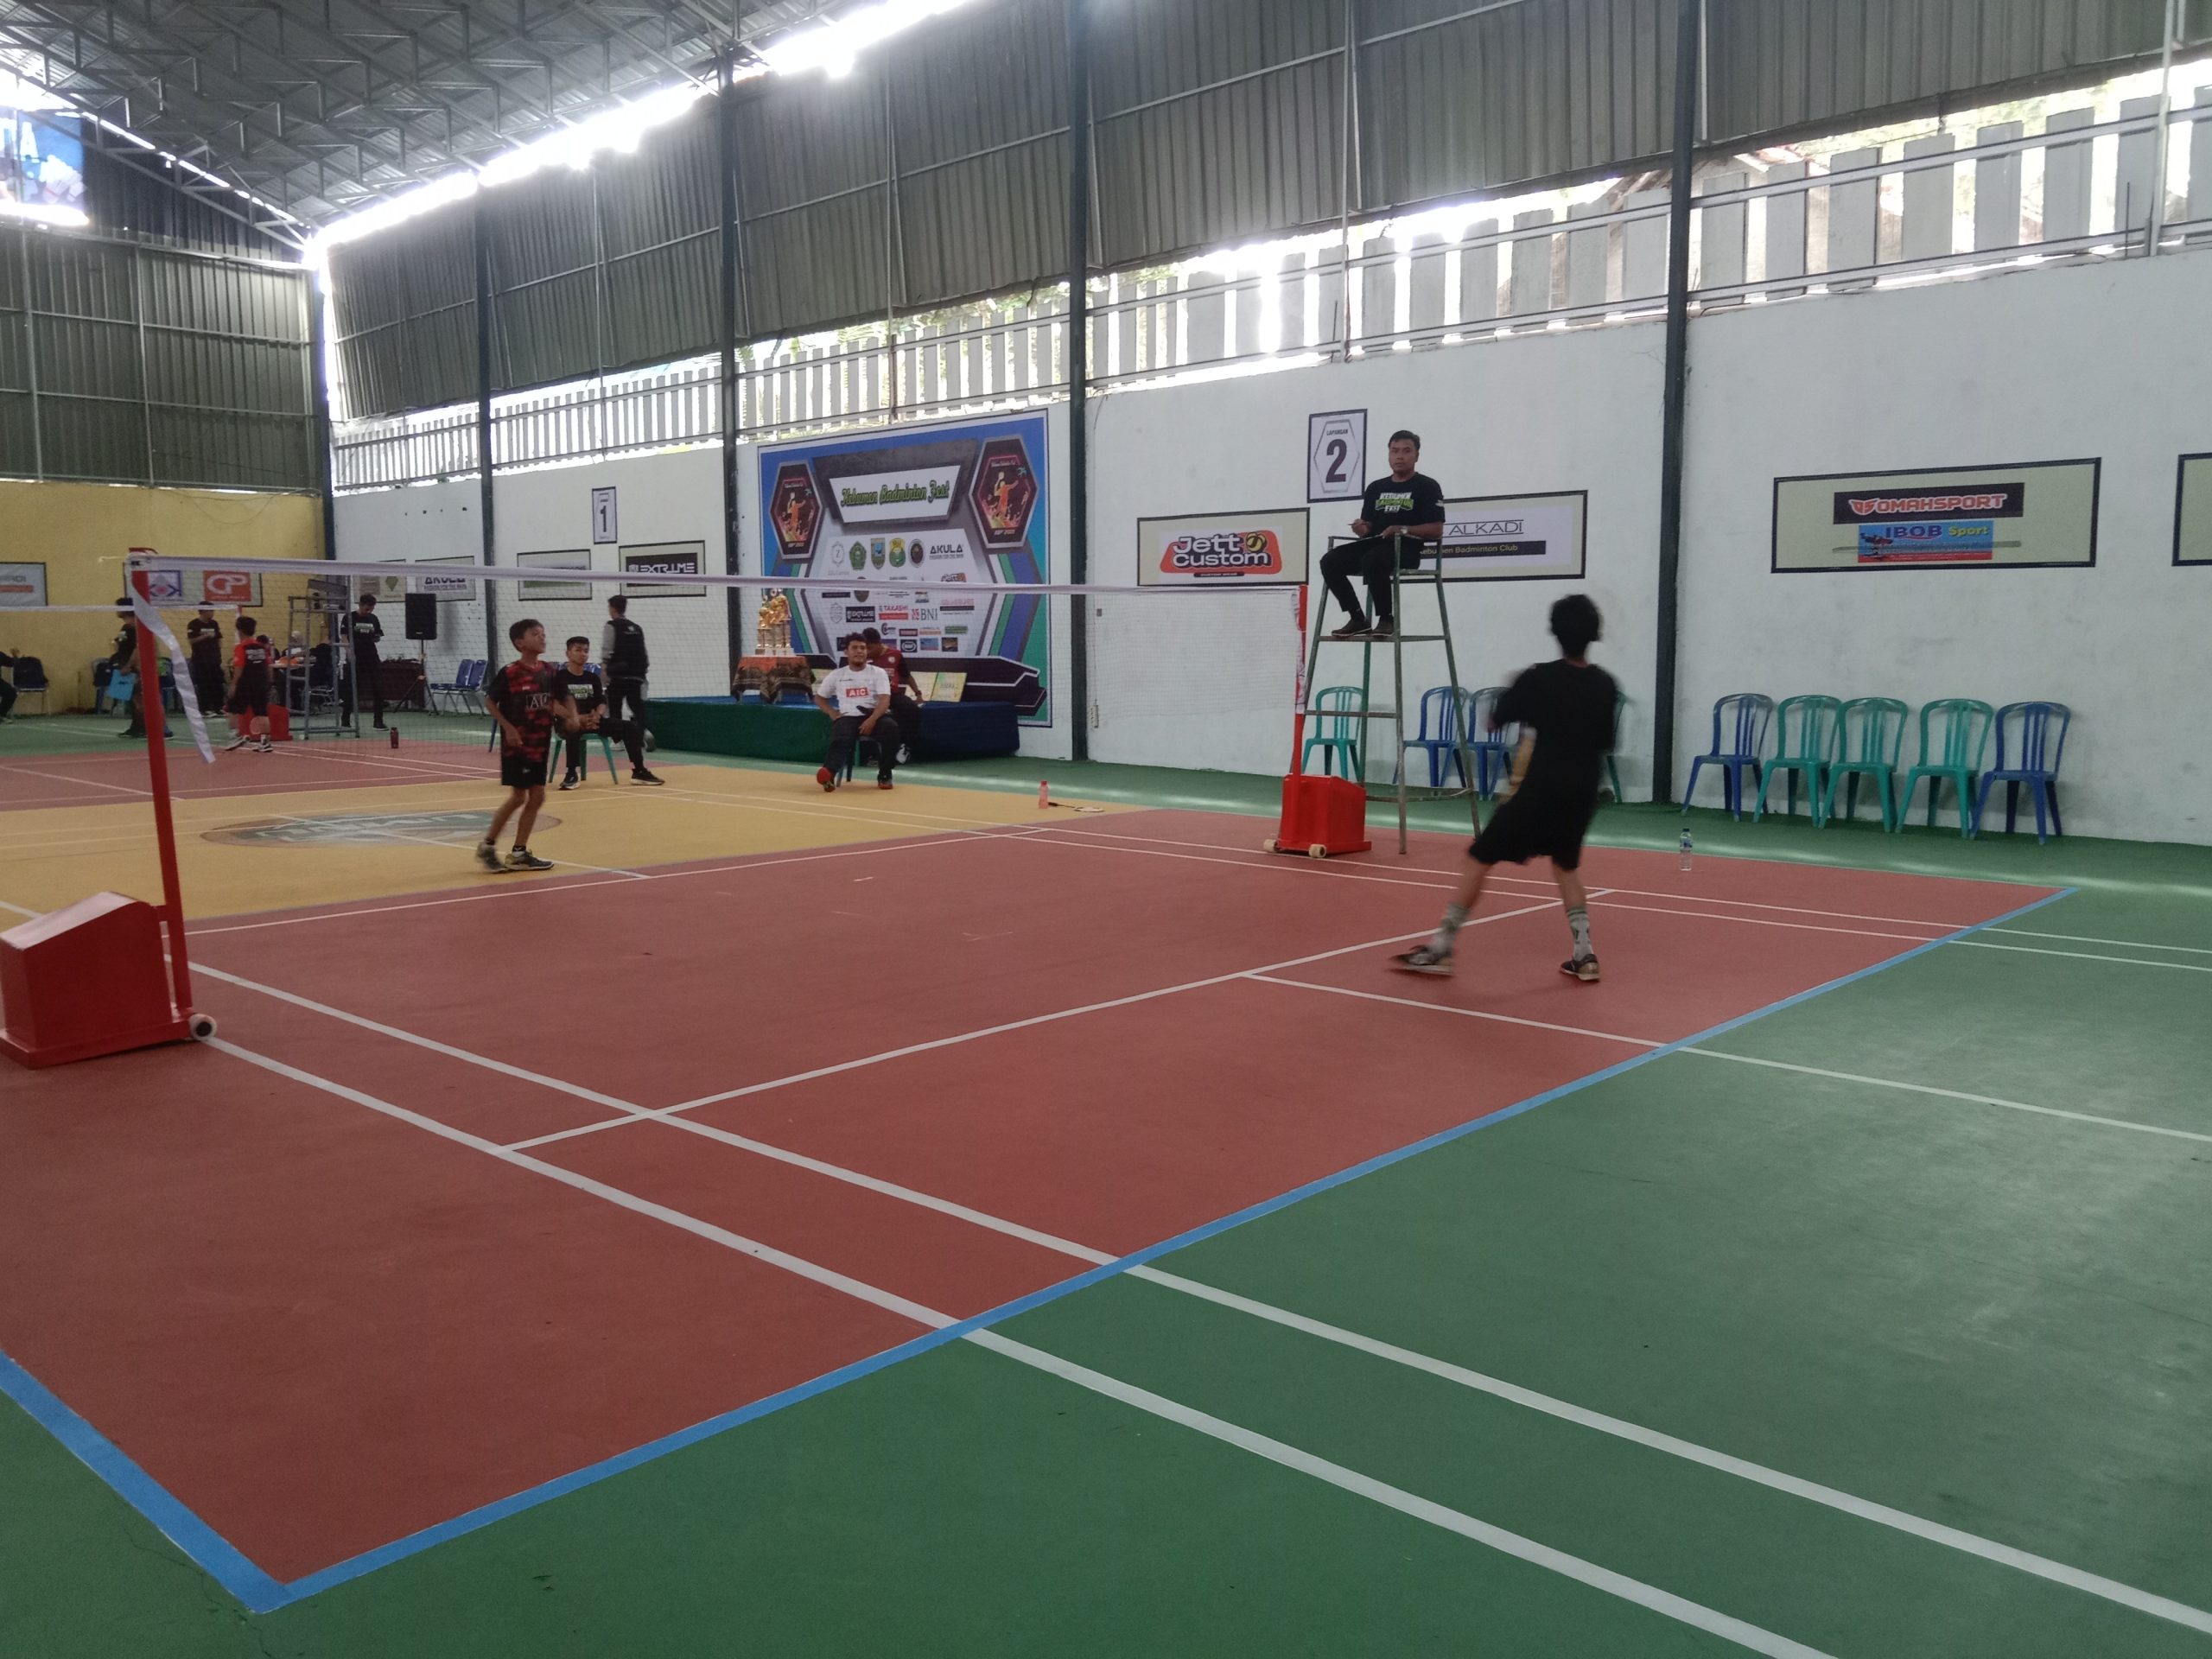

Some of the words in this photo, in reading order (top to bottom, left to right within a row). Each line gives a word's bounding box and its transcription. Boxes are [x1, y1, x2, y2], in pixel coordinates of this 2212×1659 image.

[1325, 439, 1348, 484] 2
[1877, 494, 2007, 514] OMAHSPORT
[600, 505, 607, 532] 1
[1448, 520, 1522, 536] ALKADI
[1885, 525, 1942, 538] IBOB
[1948, 526, 1989, 537] Sport
[930, 543, 963, 554] AKULA
[1173, 532, 1242, 554] Jett
[1455, 544, 1498, 554] Badminton
[1499, 543, 1519, 552] Club
[920, 607, 938, 620] BNI
